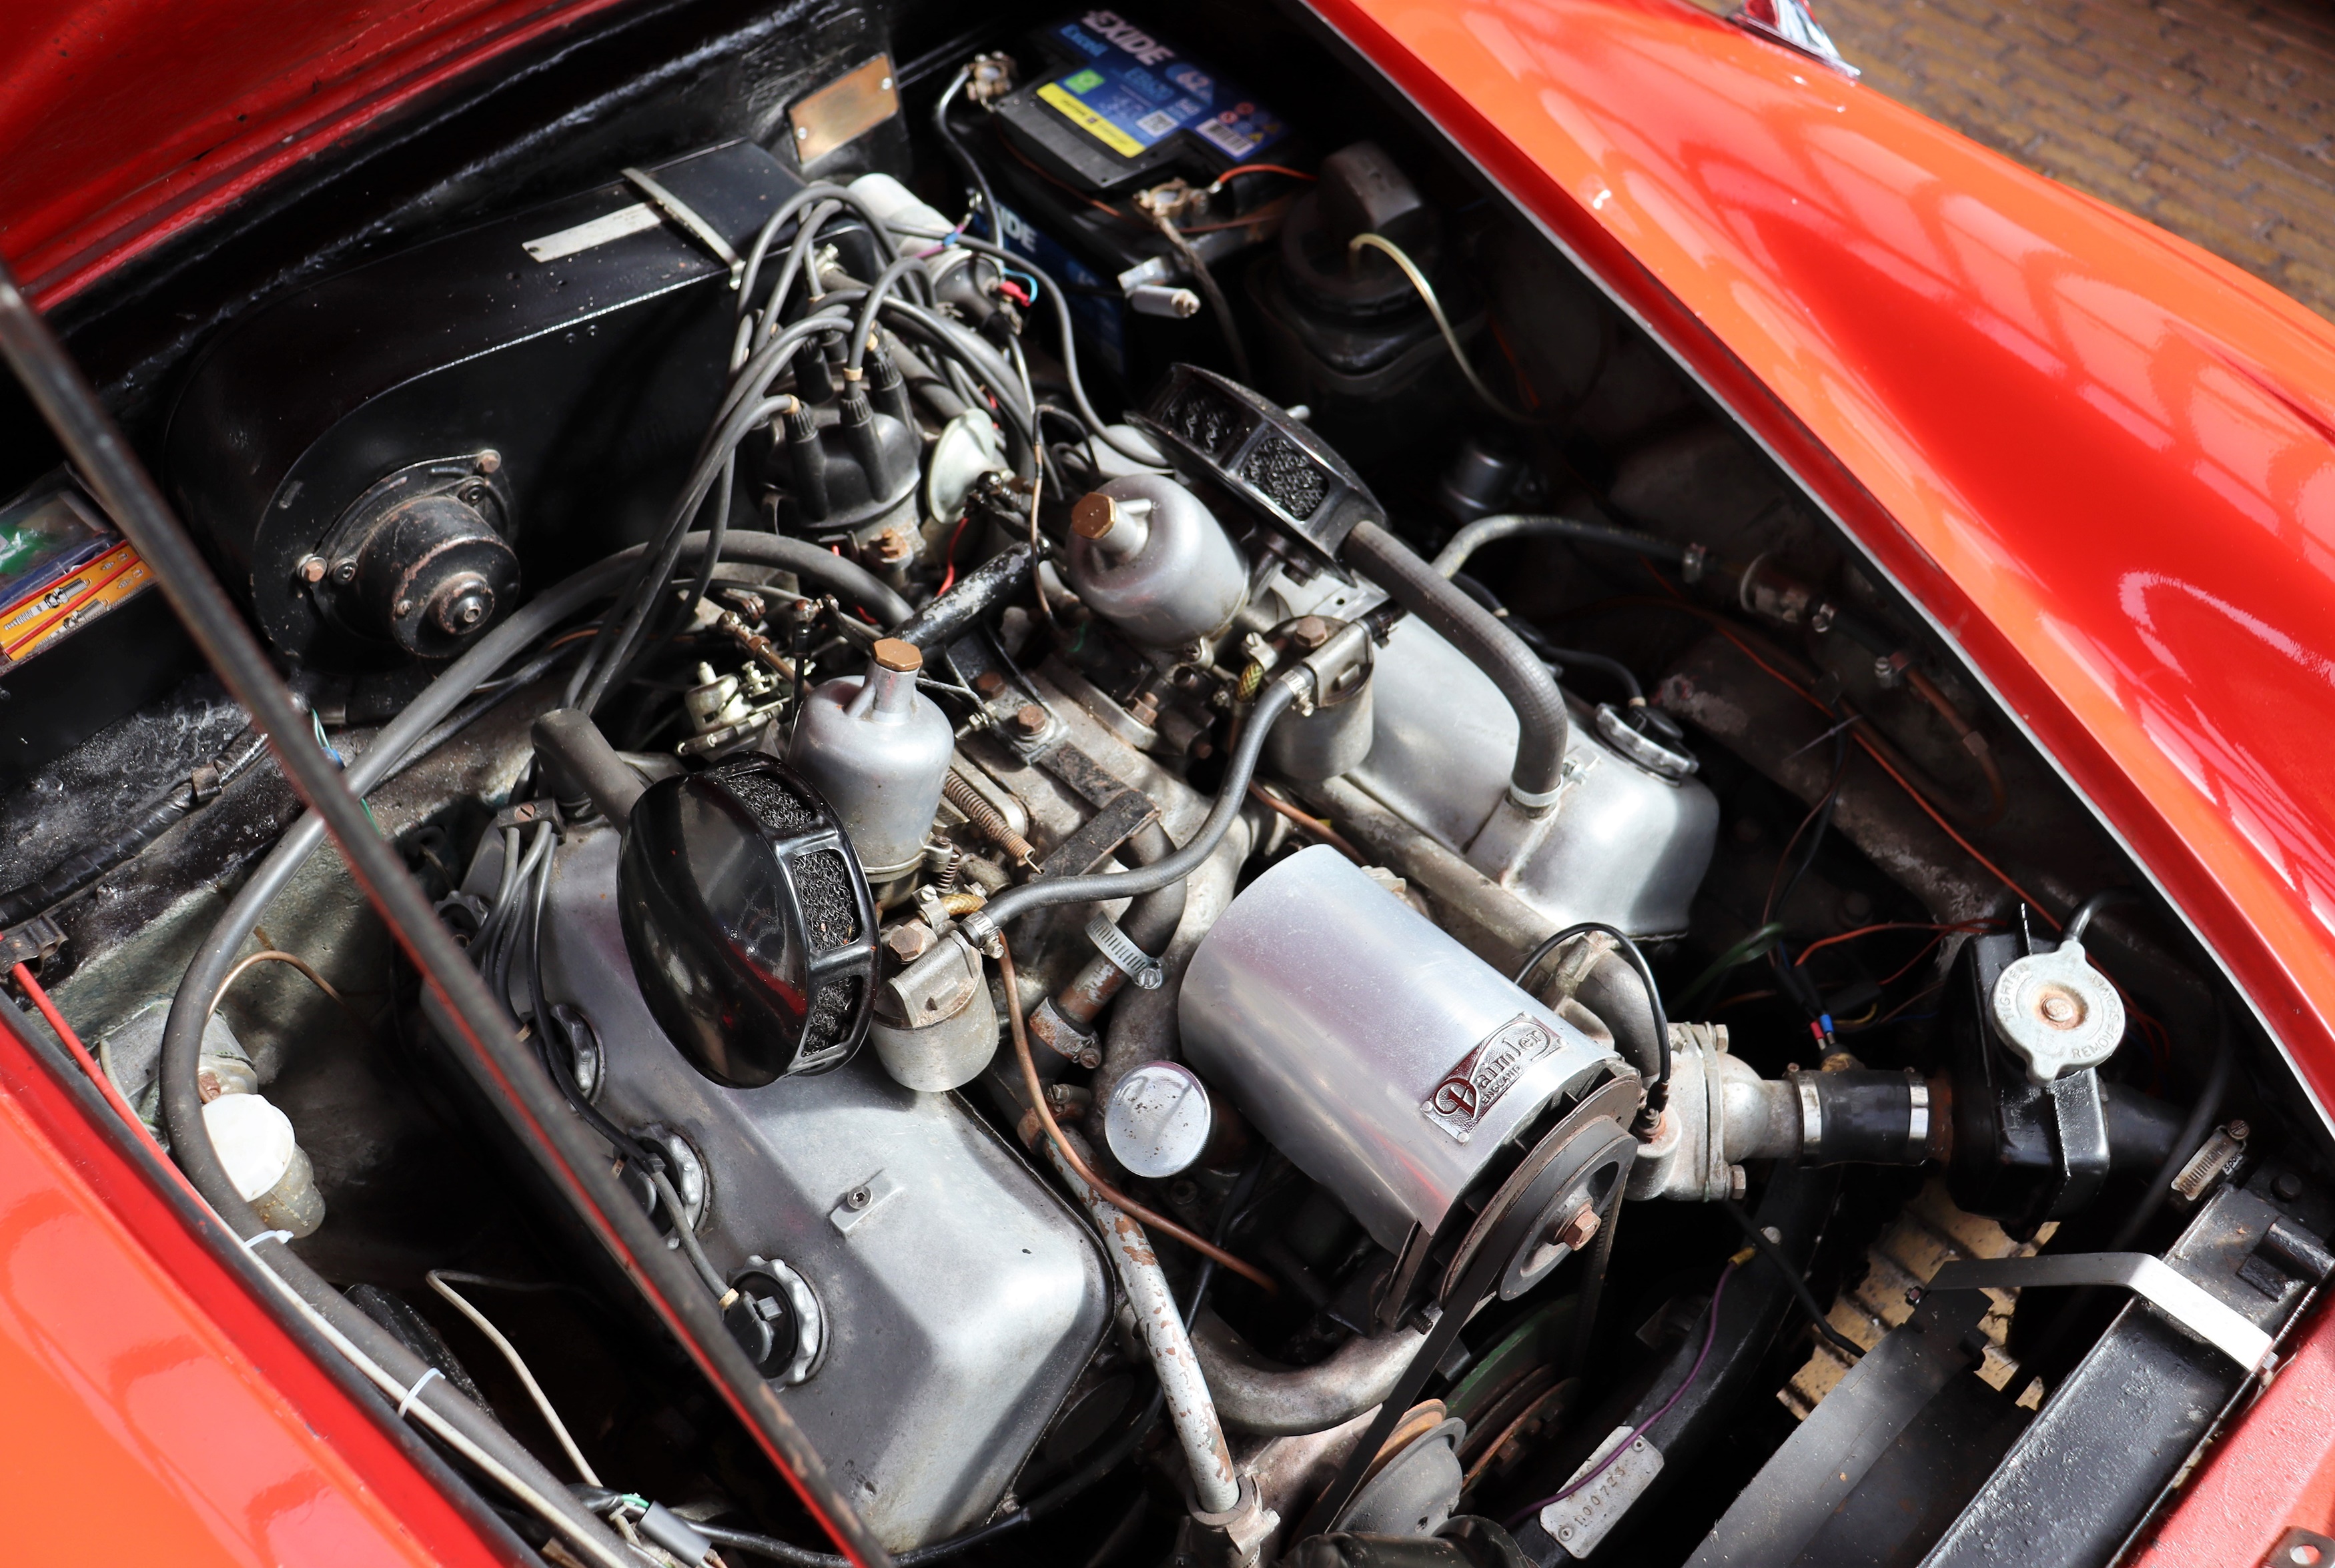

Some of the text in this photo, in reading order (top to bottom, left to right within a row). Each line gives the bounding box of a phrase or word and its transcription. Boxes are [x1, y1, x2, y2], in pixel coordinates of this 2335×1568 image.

[1081, 10, 1175, 66] EXIDE
[1999, 964, 2029, 1022] TIGHTEN
[2071, 1025, 2119, 1059] REMOVE
[1434, 1027, 1545, 1119] Daimler
[1482, 1066, 1521, 1104] ENGLAND
